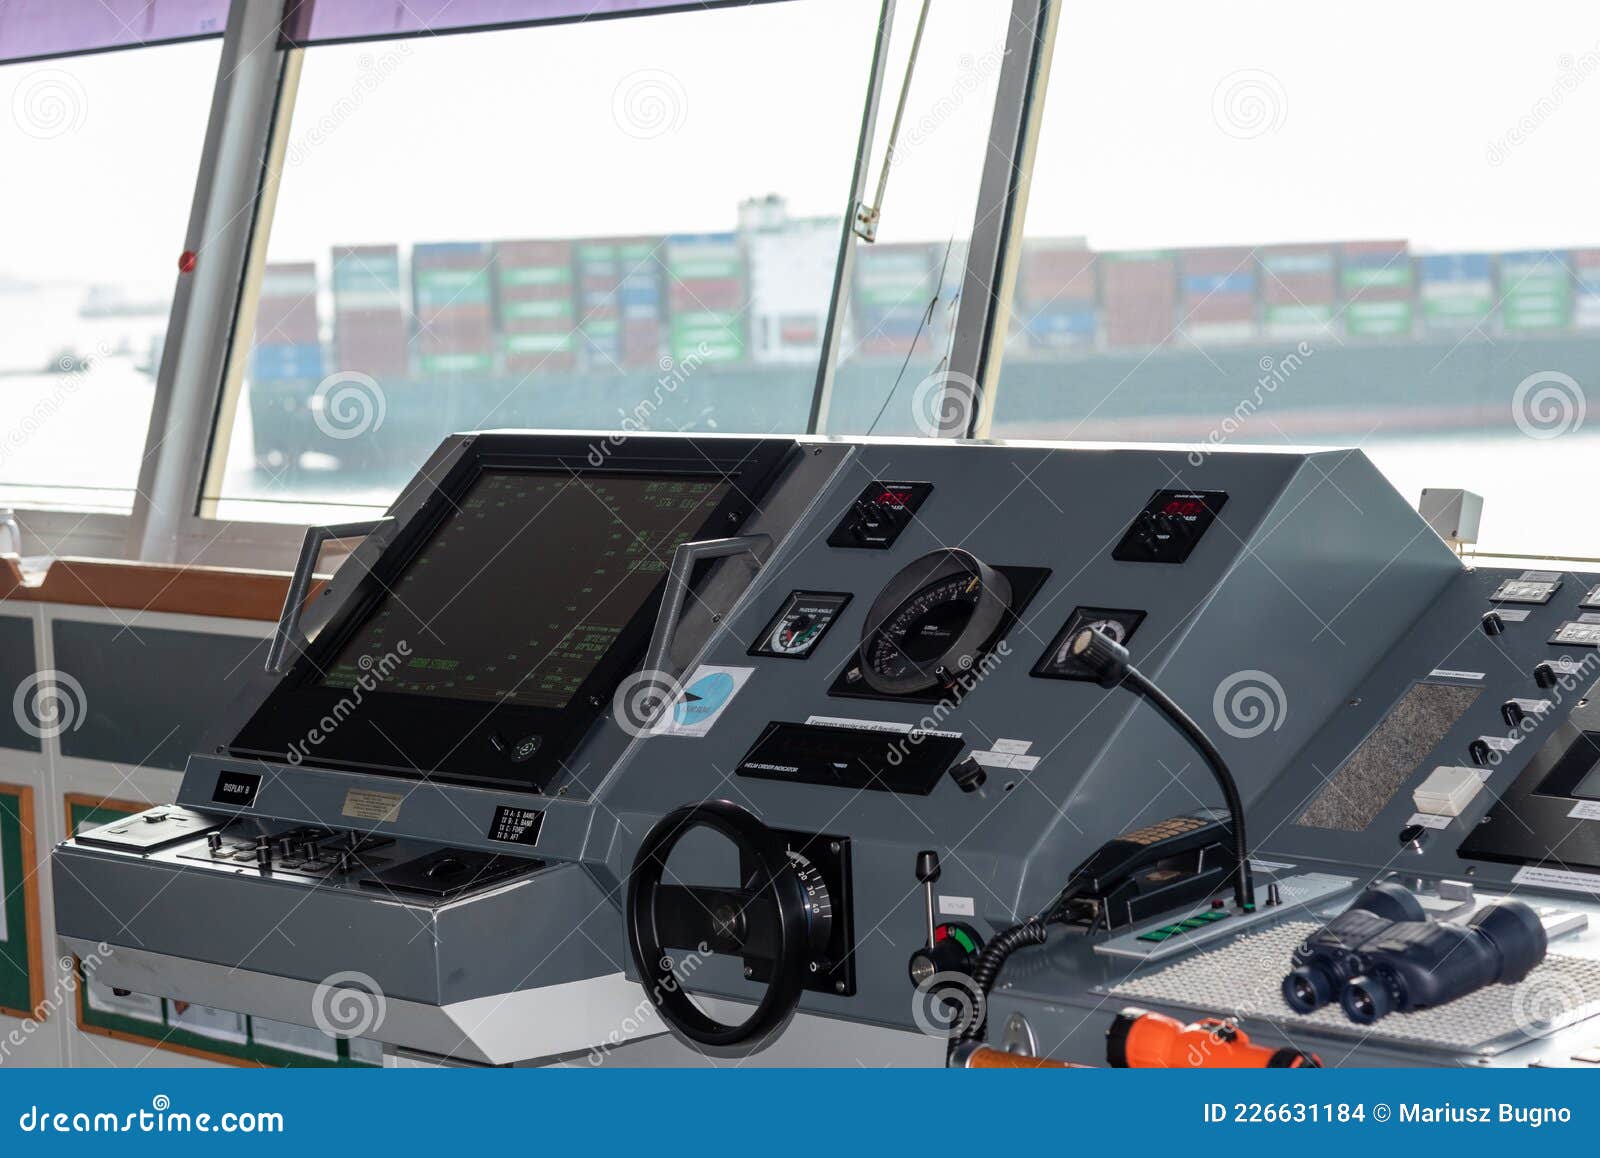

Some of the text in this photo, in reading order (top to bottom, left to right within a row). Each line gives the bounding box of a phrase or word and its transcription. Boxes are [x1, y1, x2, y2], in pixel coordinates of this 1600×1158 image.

[223, 783, 244, 793] DISPLAY
[797, 871, 807, 881] 20
[806, 885, 815, 896] 30
[812, 903, 820, 914] 40
